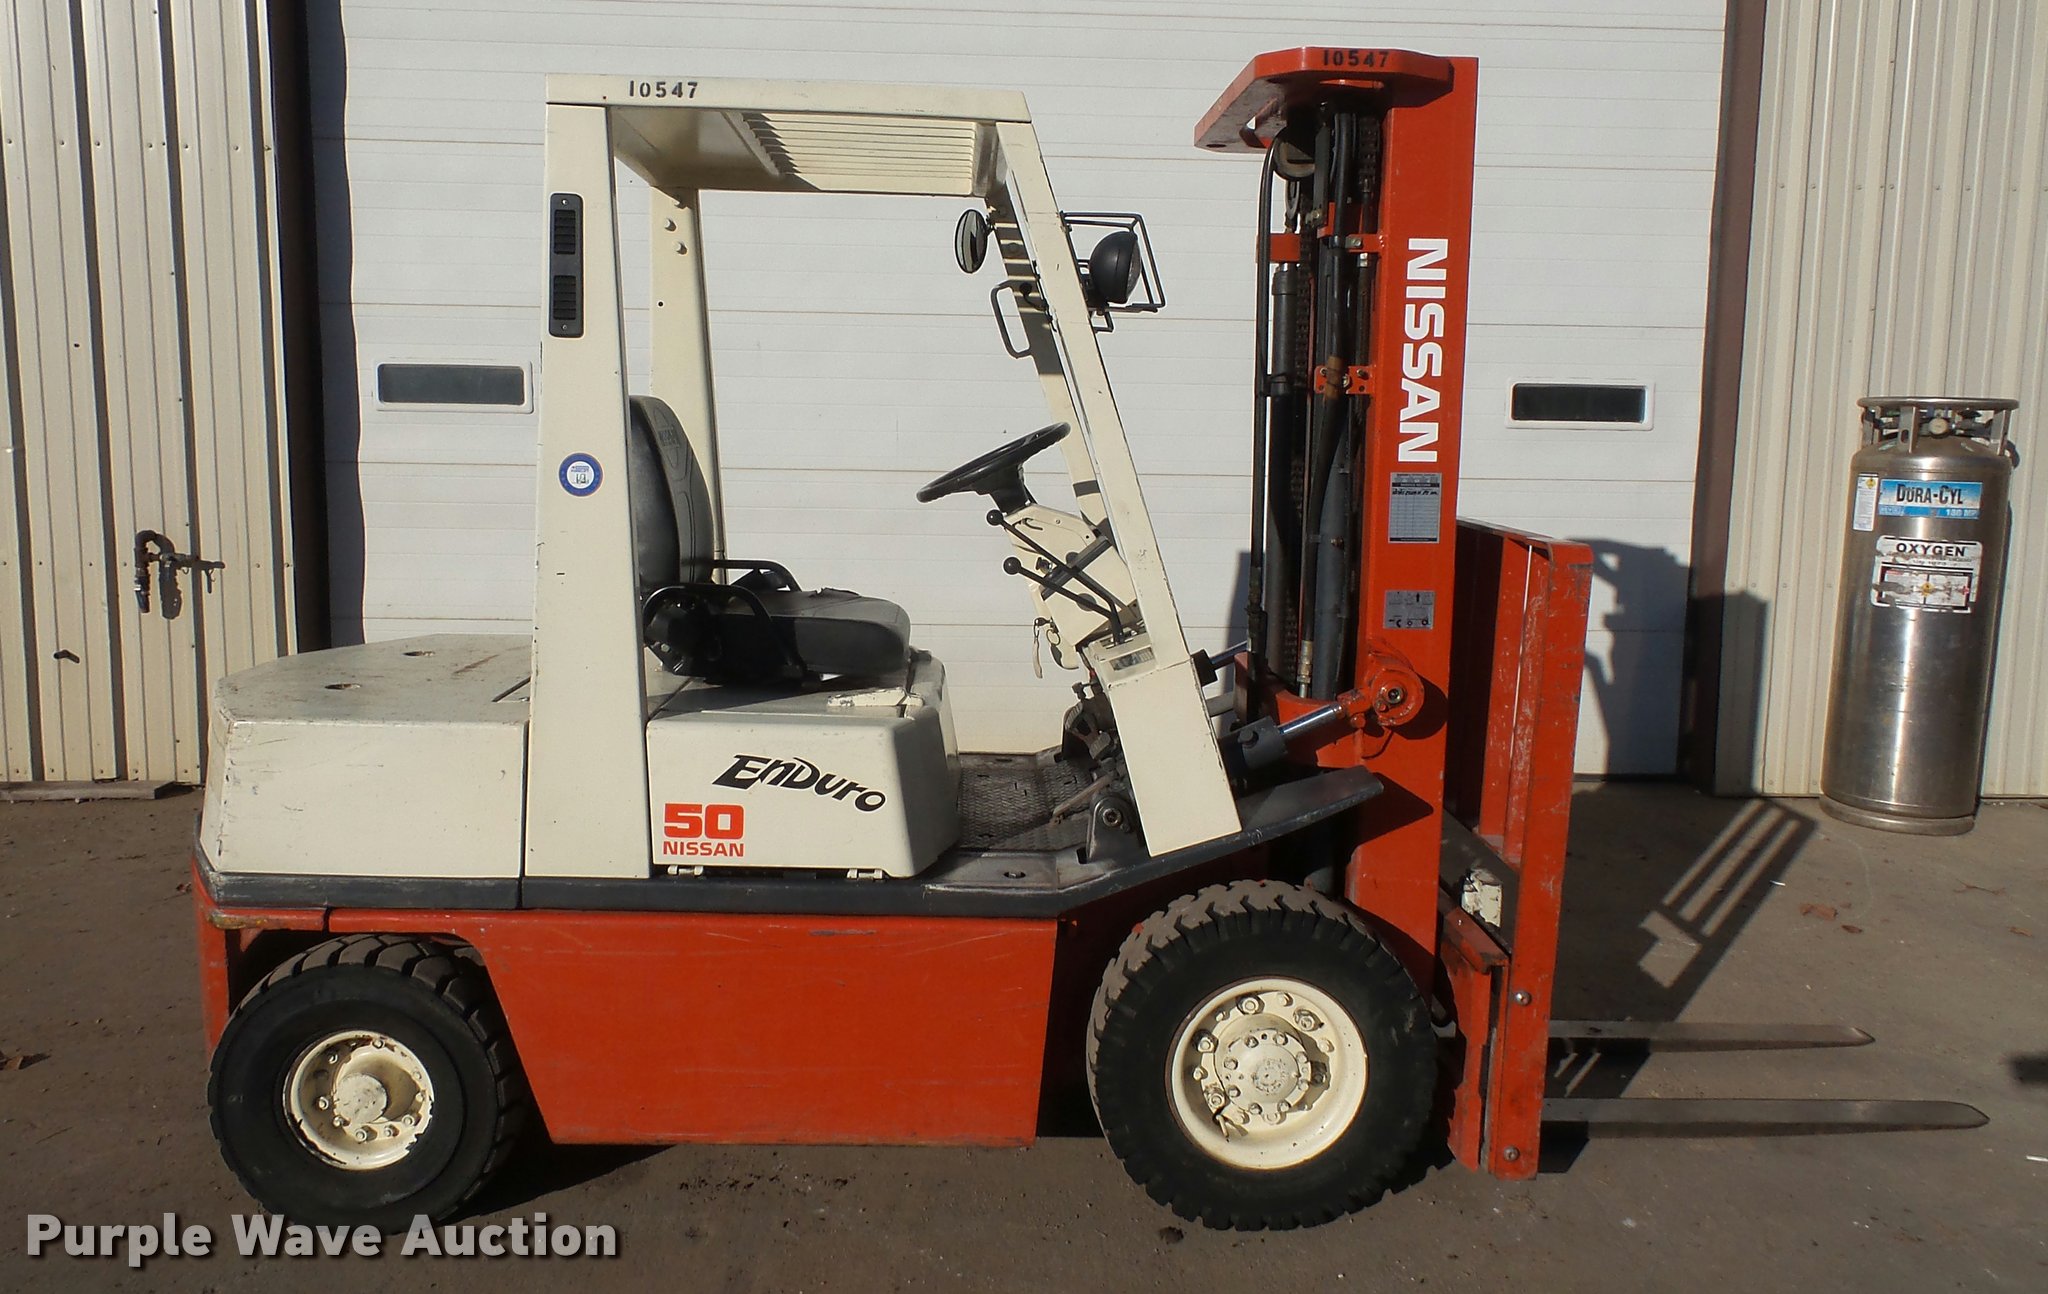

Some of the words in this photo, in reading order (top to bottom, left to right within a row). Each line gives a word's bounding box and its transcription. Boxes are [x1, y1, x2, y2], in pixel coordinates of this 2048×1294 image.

[1323, 49, 1389, 68] 10547
[629, 80, 698, 99] 10547
[1398, 238, 1449, 463] NISSAN
[1896, 543, 1966, 557] OXYGEN
[664, 803, 744, 839] 50
[663, 841, 744, 857] NISSAN
